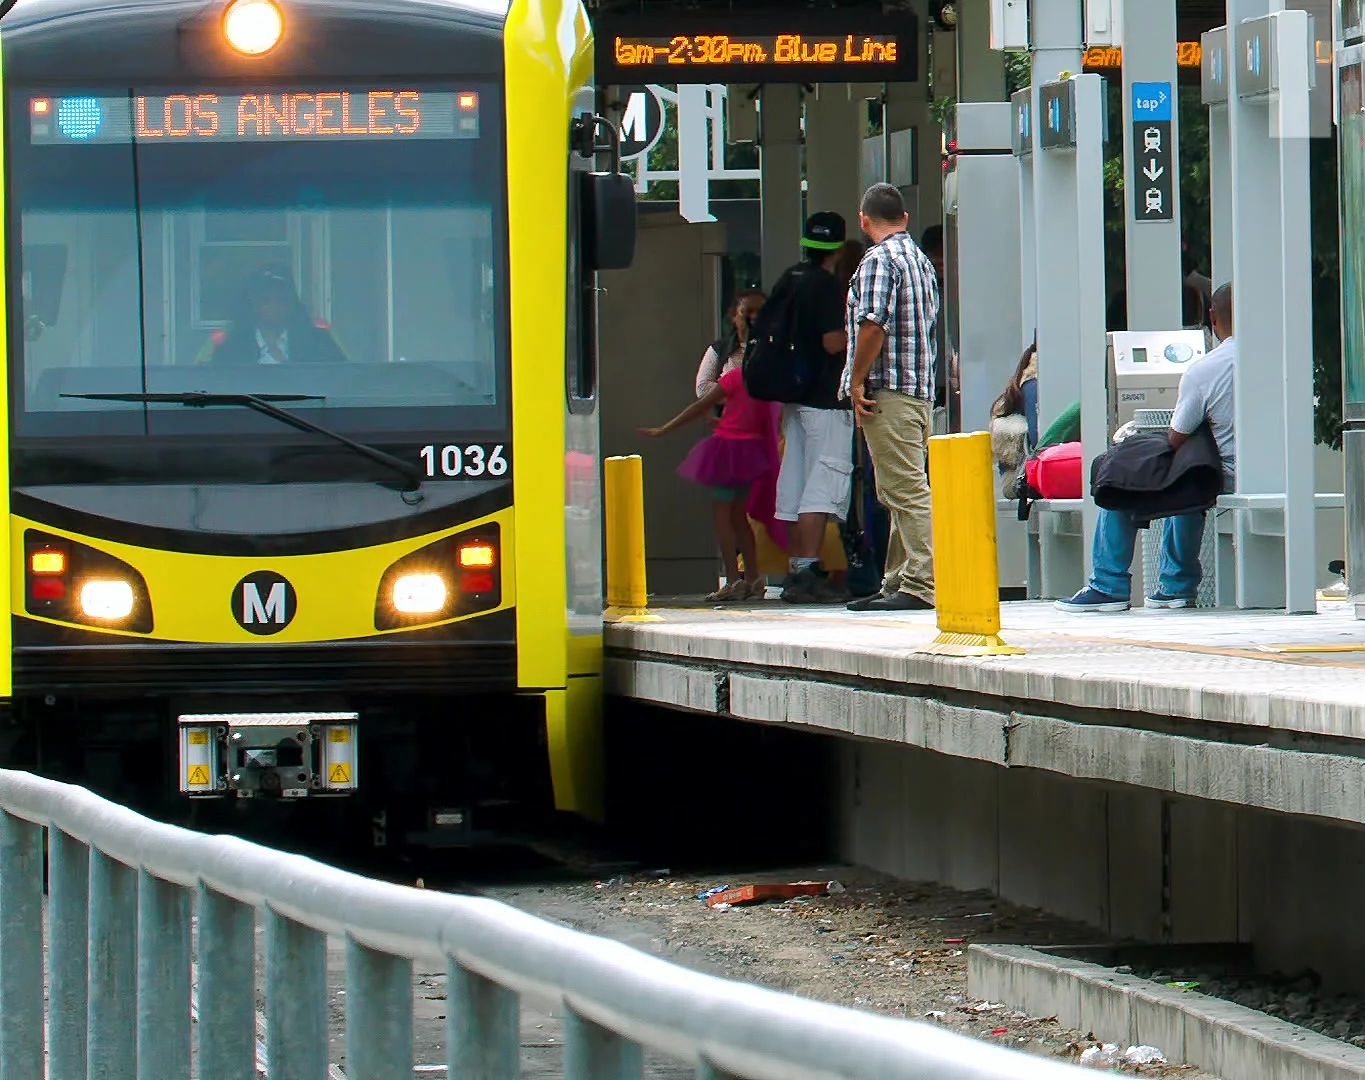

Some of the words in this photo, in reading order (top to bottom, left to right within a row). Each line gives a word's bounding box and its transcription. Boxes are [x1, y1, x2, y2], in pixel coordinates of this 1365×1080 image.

[774, 34, 836, 62] Blue
[844, 34, 898, 62] Line
[138, 94, 219, 137] LOS
[237, 90, 421, 137] ANGELES
[1136, 97, 1159, 112] tap
[420, 444, 508, 477] 1036
[242, 582, 286, 625] M
